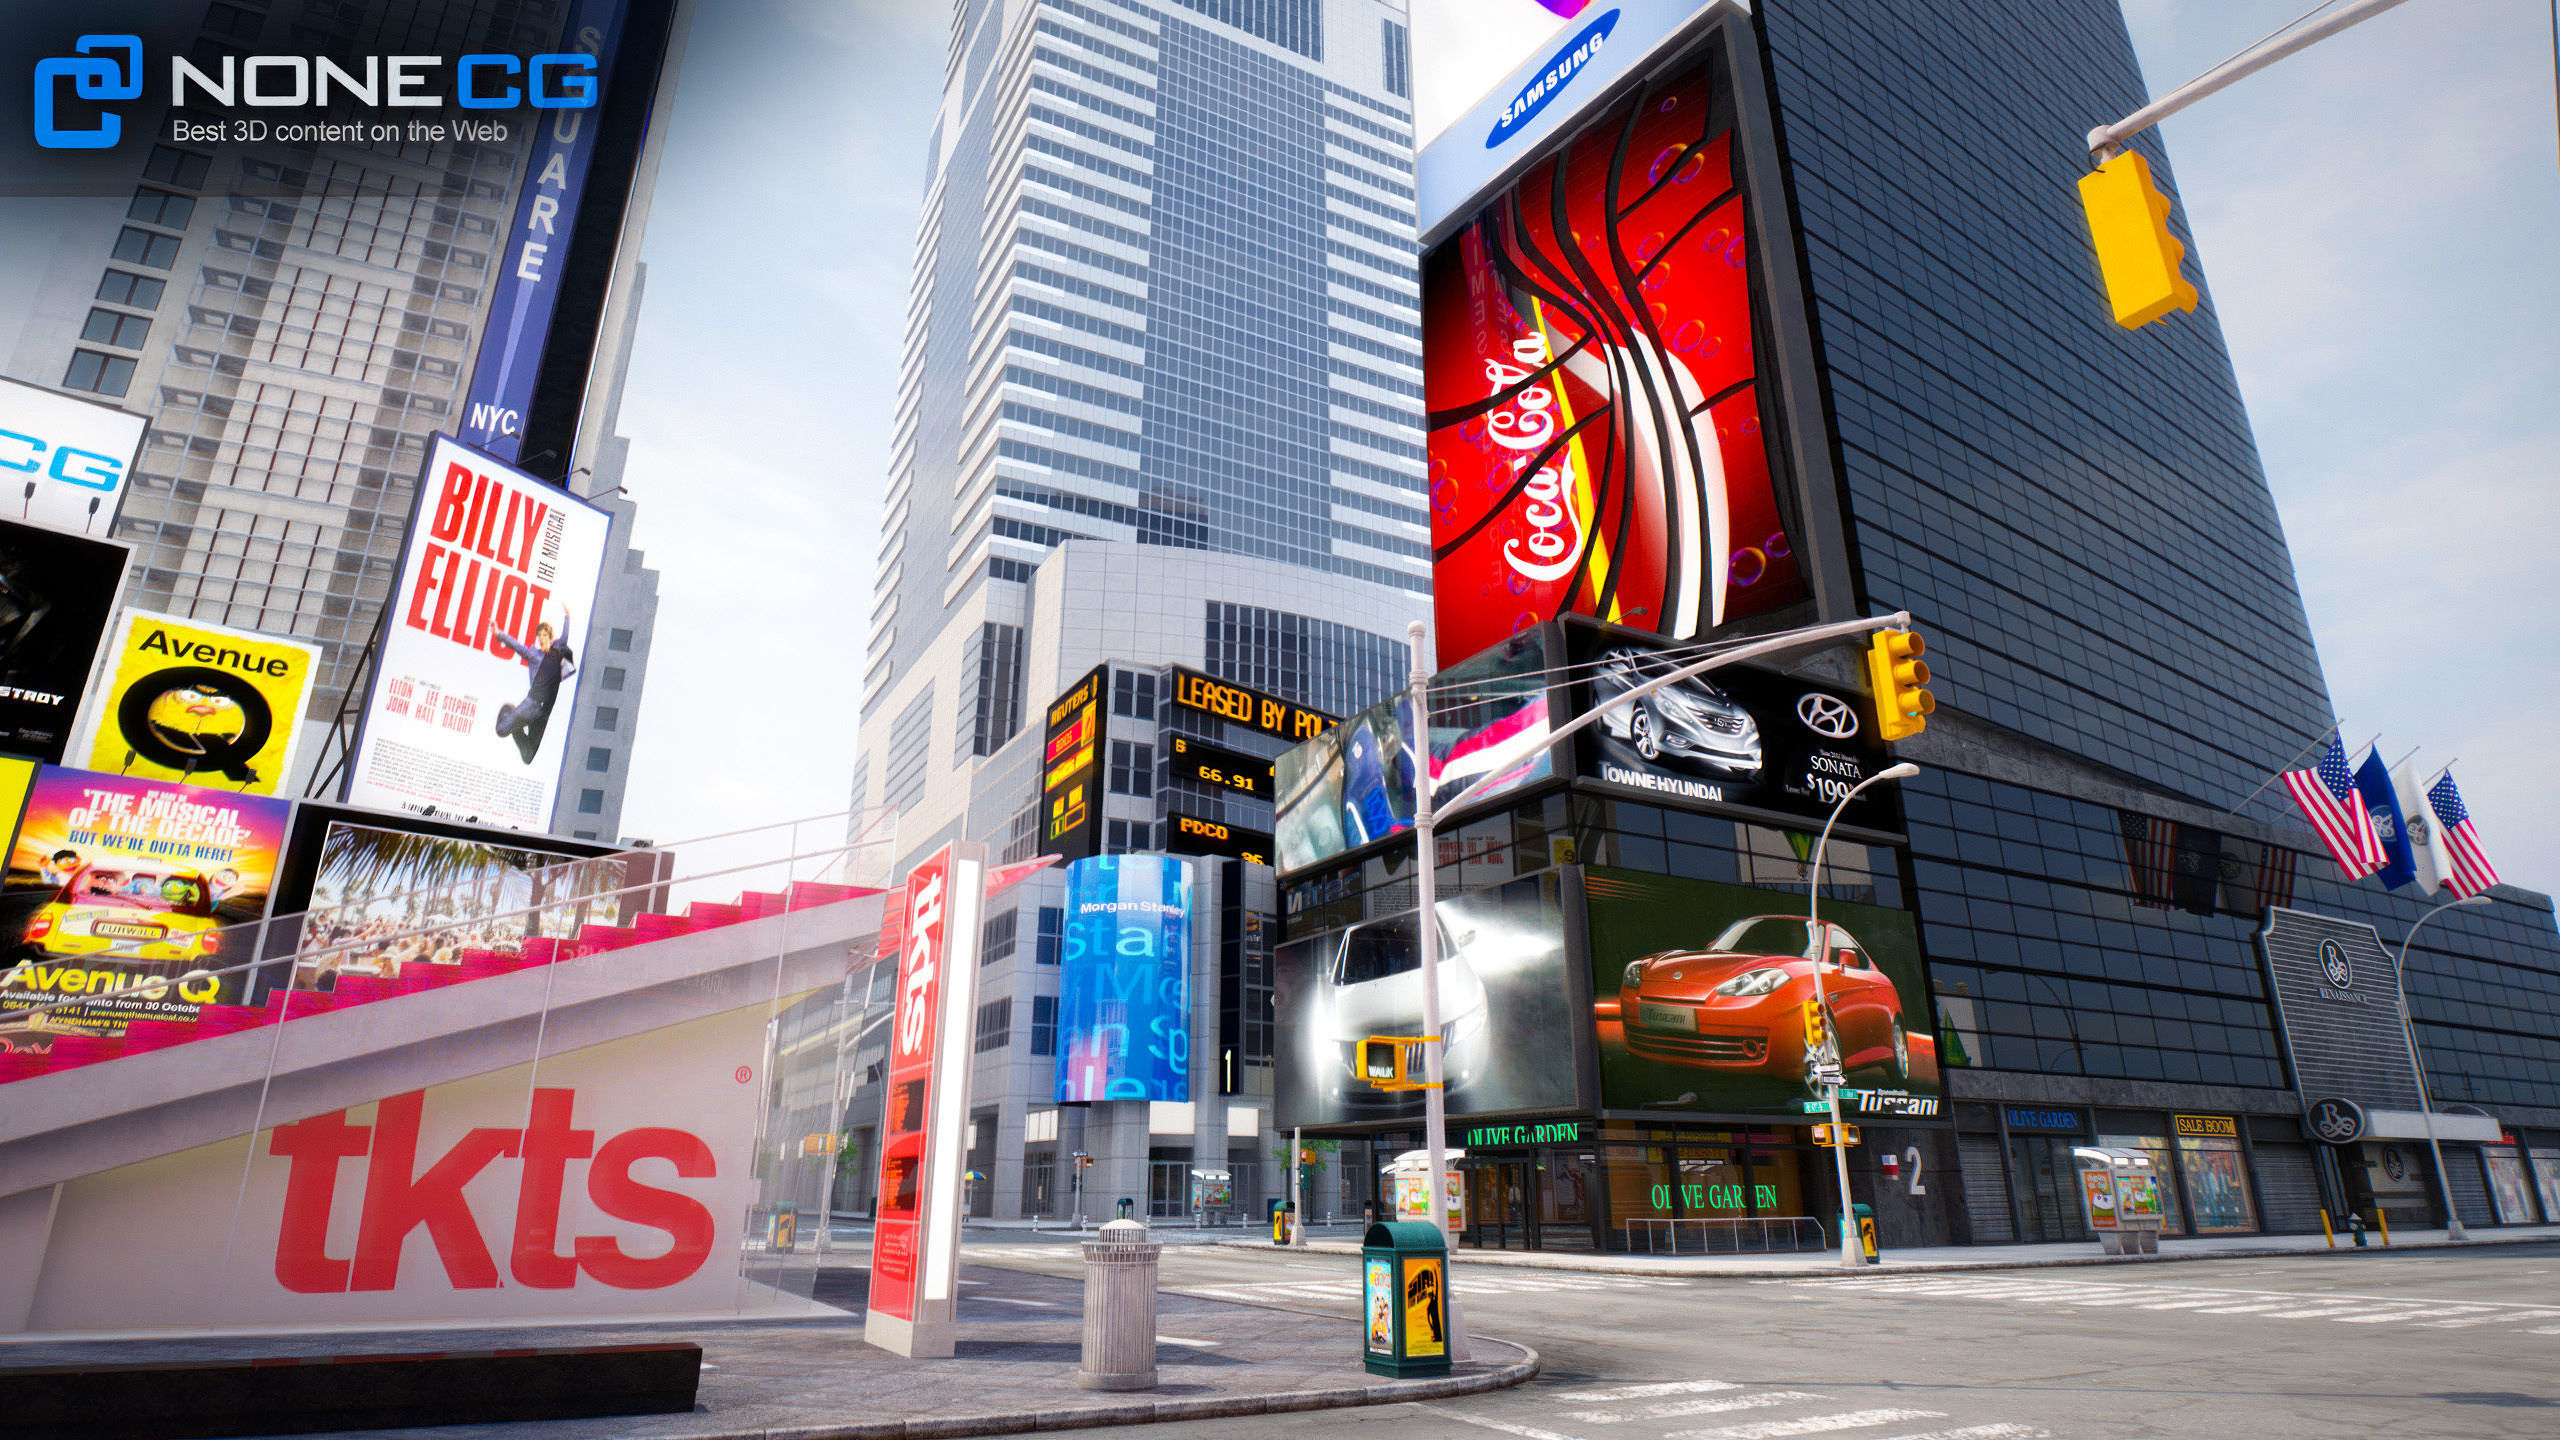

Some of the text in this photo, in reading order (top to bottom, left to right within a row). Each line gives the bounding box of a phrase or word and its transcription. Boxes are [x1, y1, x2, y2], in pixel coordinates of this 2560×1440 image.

[1501, 33, 1604, 127] SAMSUNG
[470, 402, 518, 436] NYC
[1485, 331, 1583, 582] Coca-Cola
[430, 461, 548, 574] BILLY
[406, 542, 550, 667] ELLIOT
[139, 629, 290, 679] Avenue
[1051, 684, 1089, 728] REUTERS
[1177, 674, 1252, 722] LEASED
[1261, 700, 1286, 732] BY
[1198, 766, 1255, 791] 66.91
[1811, 755, 1862, 779] SONATA
[68, 807, 101, 829] OF
[109, 813, 152, 836] THE
[139, 797, 240, 829] MUSICAL
[69, 830, 233, 863] BUT WE'RE OUTTA HERE!
[1080, 902, 1185, 918] Morgan Stanley
[902, 872, 941, 1056] tkts
[1, 959, 221, 1005] Avenue Q
[1, 989, 55, 1001] Available
[115, 998, 142, 1010] from
[1368, 1065, 1394, 1079] WALK
[1514, 1122, 1579, 1144] GARDEN
[2007, 1110, 2078, 1129] OLIVE GARDEN
[2179, 1118, 2204, 1132] SALE
[1905, 1146, 1926, 1195] 2
[269, 1087, 717, 1293] tkts
[1651, 1184, 1777, 1209] OLVE GAREN
